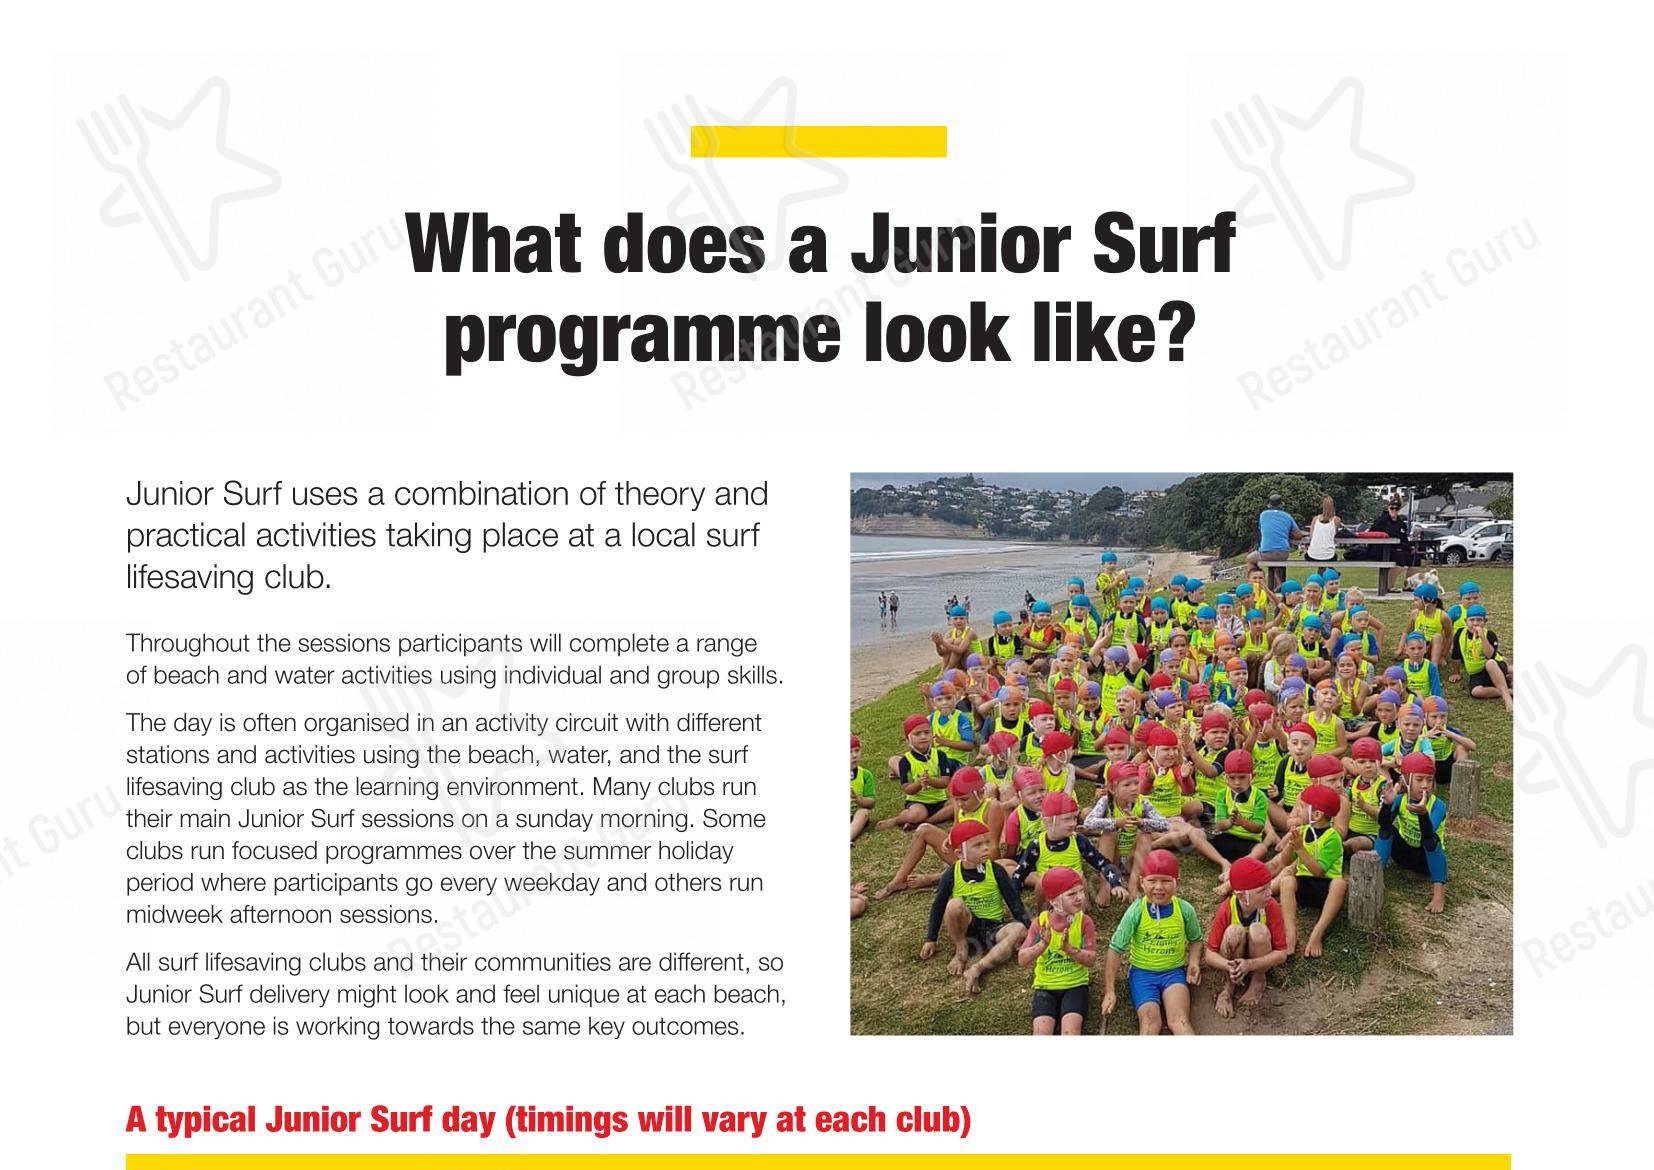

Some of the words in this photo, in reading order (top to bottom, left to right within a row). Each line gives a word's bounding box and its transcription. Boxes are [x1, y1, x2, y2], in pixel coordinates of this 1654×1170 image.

[404, 211, 582, 274] What
[603, 211, 766, 274] does
[788, 225, 828, 274] a
[850, 211, 1072, 274] Junior
[1093, 210, 1237, 274] Surf
[445, 314, 841, 377] programme
[865, 300, 1012, 363] look
[1033, 299, 1196, 363] like?
[126, 480, 215, 506] Junior
[223, 479, 283, 506] Surf
[292, 486, 358, 506] uses
[368, 486, 386, 506] a
[394, 480, 569, 506] combination
[579, 480, 607, 506] of
[614, 480, 706, 512] theory
[715, 480, 768, 506] and
[127, 563, 254, 596] lifesaving
[264, 563, 331, 590] club.
[125, 633, 250, 658] Throughout
[256, 633, 291, 653] the
[298, 633, 391, 653] sessions
[398, 633, 523, 657] participants
[529, 633, 562, 653] will
[569, 633, 670, 657] complete
[676, 637, 690, 653] a
[696, 637, 758, 658] range
[126, 665, 148, 685] of
[154, 665, 219, 685] beach
[227, 665, 267, 685] and
[274, 666, 335, 685] water
[341, 665, 433, 685] activities
[440, 665, 496, 690] using
[504, 665, 602, 685] individual
[609, 665, 650, 685] and
[657, 669, 720, 690] group
[727, 665, 783, 685] skills.
[126, 904, 224, 924] midweek
[229, 904, 332, 924] afternoon
[339, 904, 438, 924] sessions.
[126, 1016, 161, 1036] but
[168, 1020, 266, 1040] everyone
[273, 1017, 289, 1036] is
[295, 1016, 380, 1041] working
[387, 1016, 475, 1036] towards
[480, 1016, 515, 1036] the
[522, 1020, 581, 1036] same
[588, 1016, 625, 1040] key
[632, 1017, 745, 1036] outcomes.
[125, 1105, 147, 1133] A
[155, 1105, 256, 1139] typical
[265, 1105, 362, 1133] Junior
[370, 1104, 433, 1133] Surf
[441, 1105, 497, 1139] day
[505, 1105, 629, 1139] (timings
[637, 1105, 692, 1133] will
[701, 1110, 768, 1139] vary
[776, 1105, 807, 1133] at
[815, 1105, 886, 1133] each
[896, 1105, 971, 1139] club)
